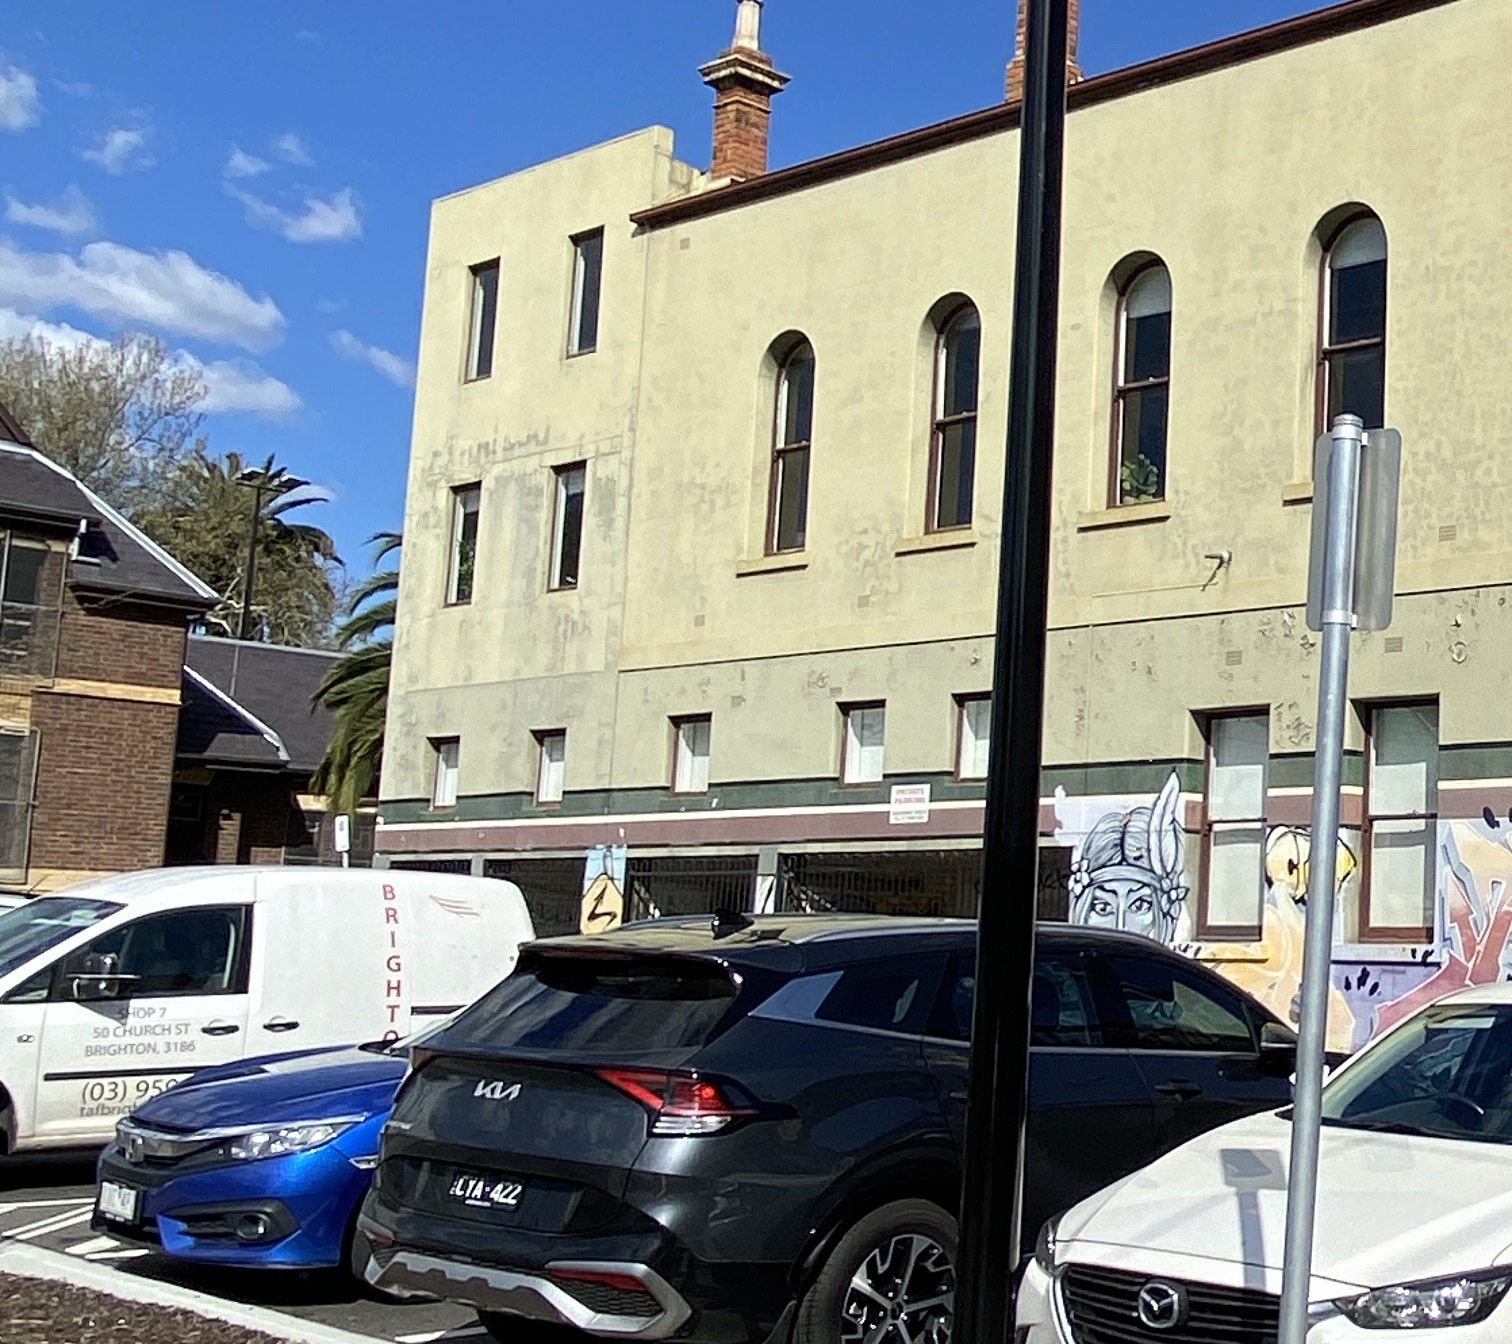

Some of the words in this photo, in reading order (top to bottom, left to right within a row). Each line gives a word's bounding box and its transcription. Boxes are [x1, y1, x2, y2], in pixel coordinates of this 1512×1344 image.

[117, 1006, 156, 1020] SHOP
[159, 1006, 167, 1018] 7
[92, 1027, 110, 1039] 50
[113, 1023, 171, 1038] CHURCH
[174, 1023, 191, 1035] ST
[163, 1040, 196, 1053] 3186
[81, 1080, 127, 1105] (03)
